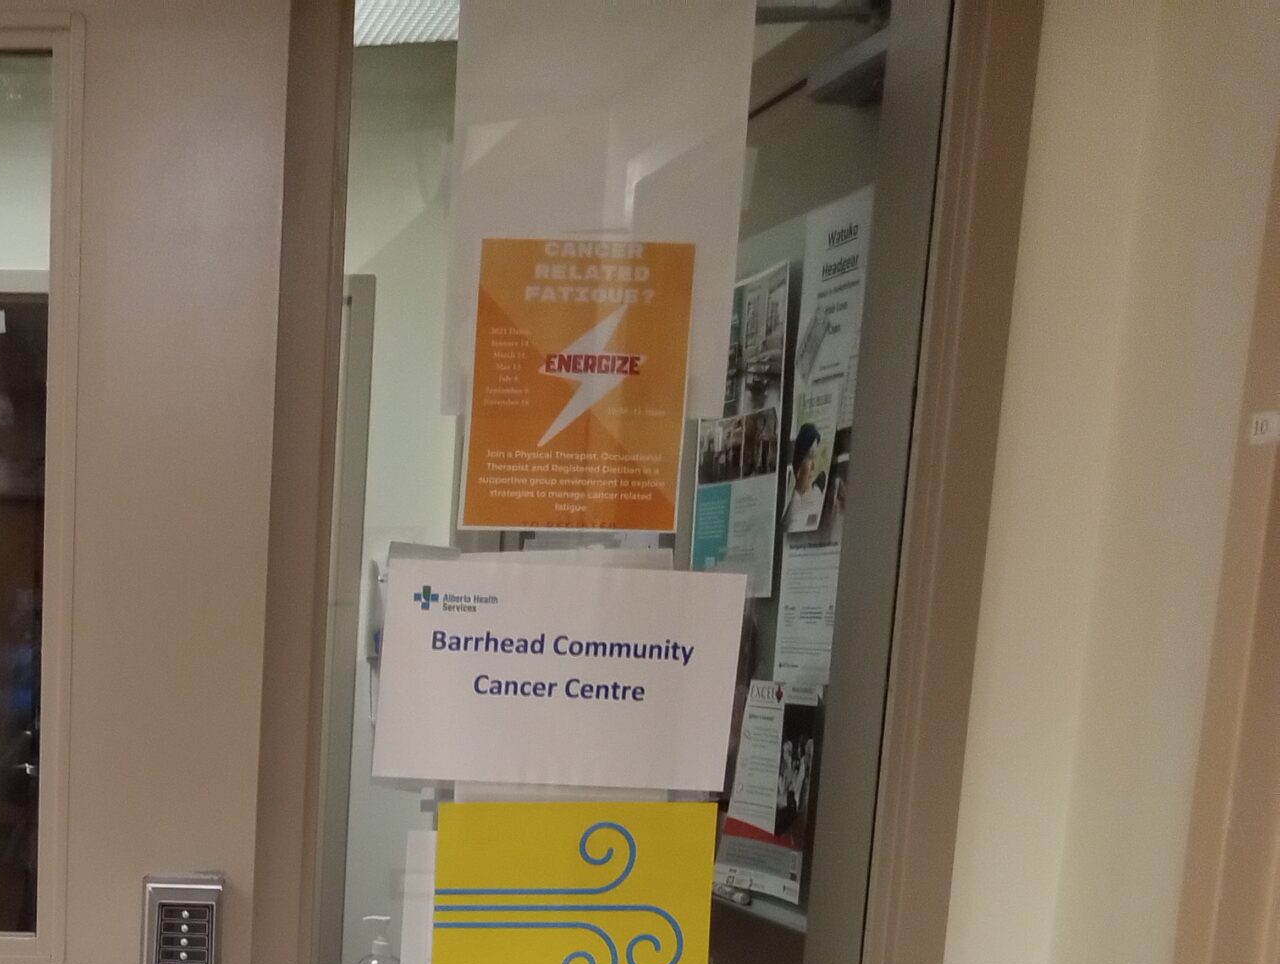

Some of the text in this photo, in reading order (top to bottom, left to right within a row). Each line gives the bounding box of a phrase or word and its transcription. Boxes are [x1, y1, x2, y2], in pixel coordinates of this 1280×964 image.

[544, 240, 643, 258] CANCER
[535, 263, 650, 281] RELATED
[525, 285, 655, 303] FATIGUE?
[545, 353, 641, 375] ENERGIZE
[486, 449, 505, 459] Join
[515, 450, 552, 462] Physical
[487, 462, 529, 474] Therapist
[532, 463, 550, 472] and
[551, 464, 600, 476] Registered
[479, 476, 528, 487] supportive
[529, 477, 557, 487] group
[559, 478, 617, 487] environment
[631, 480, 666, 490] explore
[489, 489, 652, 501] strategies to manage cancer related
[554, 503, 587, 514] fatigue
[442, 592, 498, 605] Alberta Health
[442, 603, 477, 613] Services
[431, 630, 695, 667] Barrhead Community
[473, 674, 646, 702] Cancer Centre
